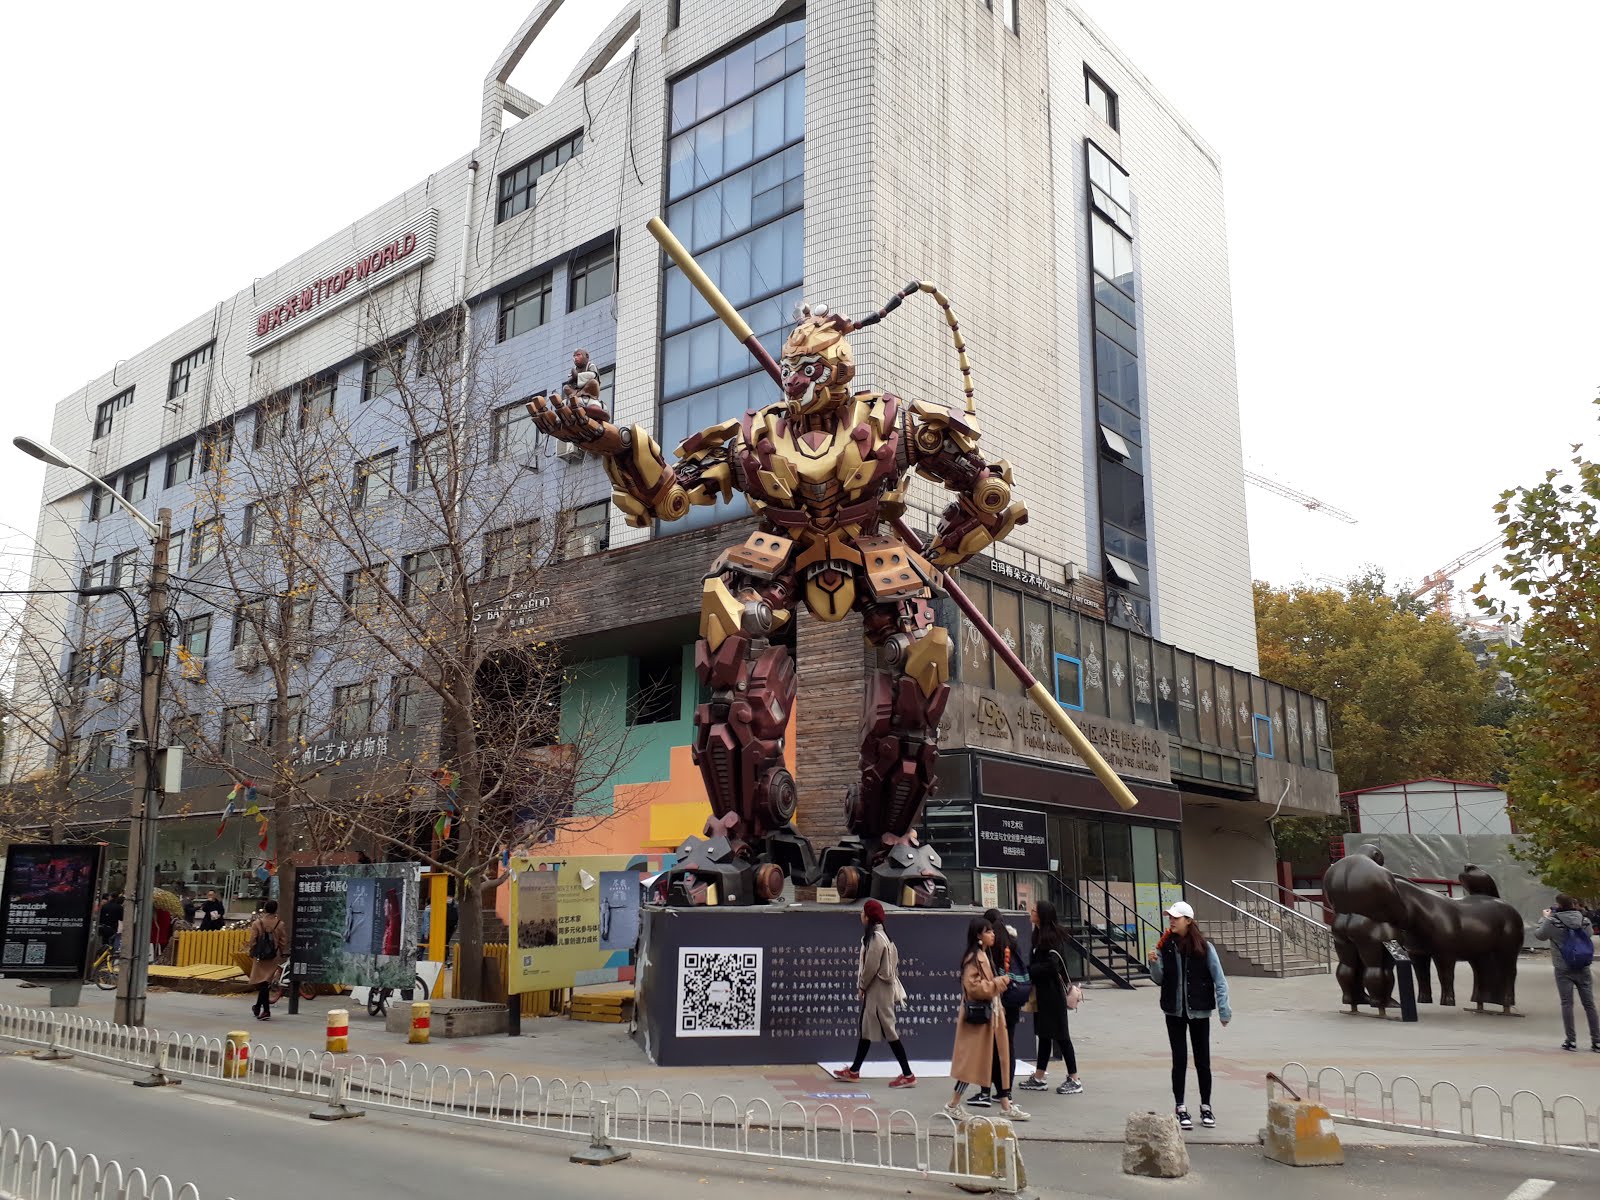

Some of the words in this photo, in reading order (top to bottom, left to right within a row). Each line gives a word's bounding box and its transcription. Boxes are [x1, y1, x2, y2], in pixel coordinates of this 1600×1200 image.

[324, 266, 353, 299] TOP
[356, 232, 416, 281] WORLD
[991, 560, 1050, 591] 白玛梅朵艺术中心
[1084, 599, 1101, 609] CENTER
[1024, 734, 1046, 749] Public
[1047, 739, 1070, 756] Service
